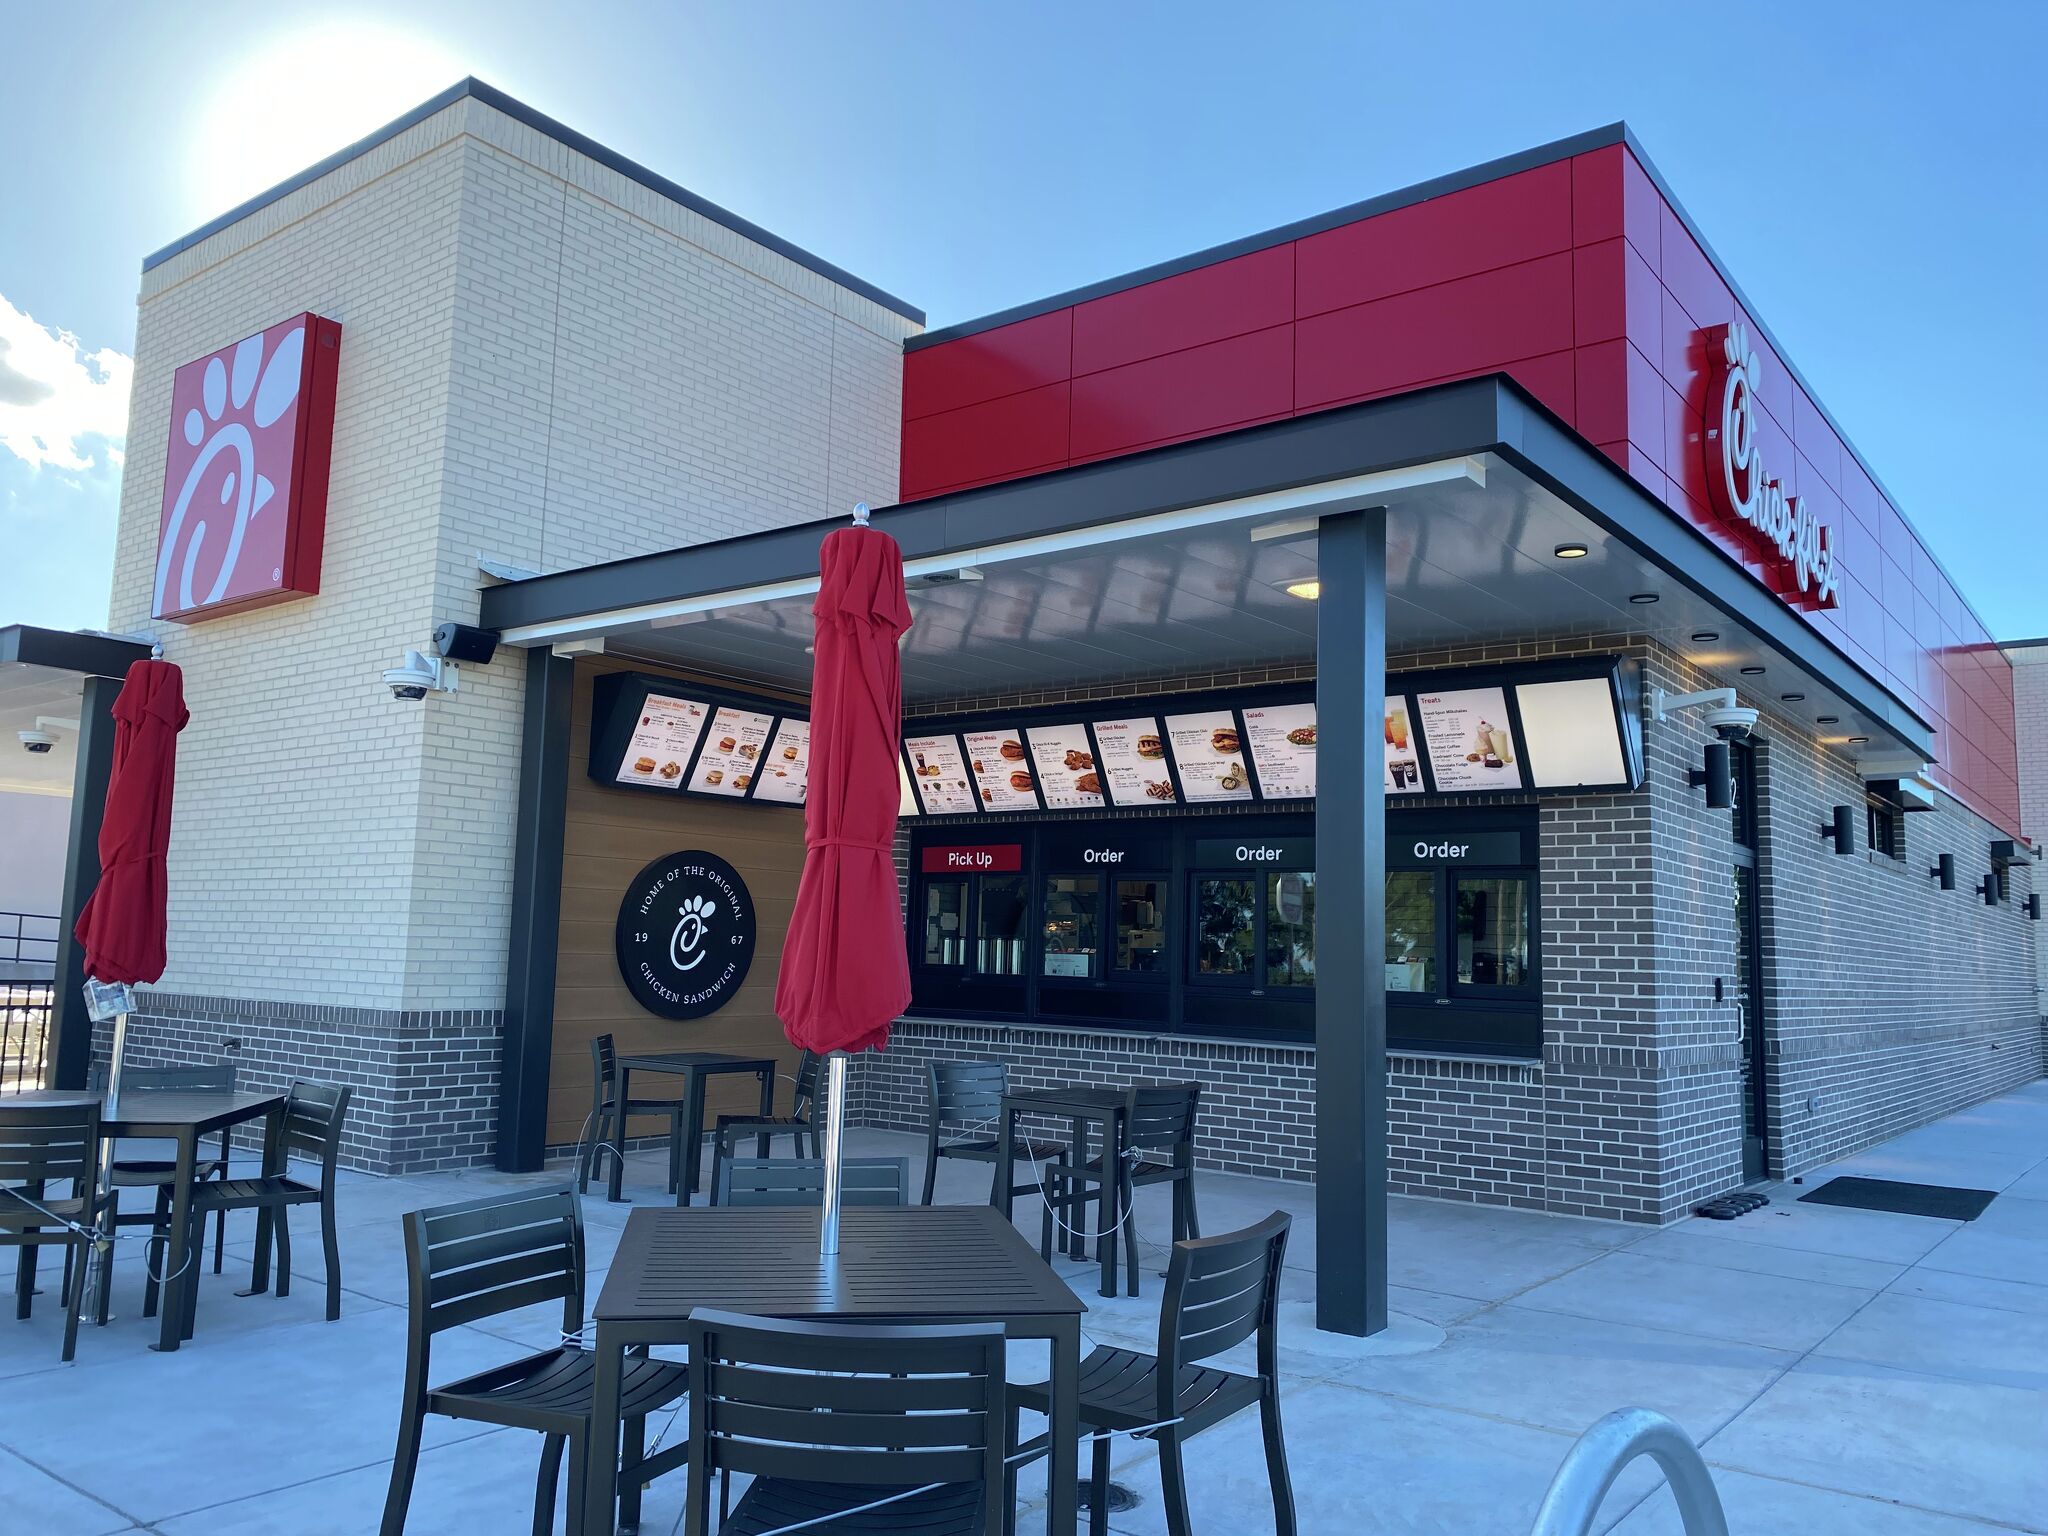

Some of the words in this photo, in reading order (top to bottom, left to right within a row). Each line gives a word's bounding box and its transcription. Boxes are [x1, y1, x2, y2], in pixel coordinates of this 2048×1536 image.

[1722, 322, 1840, 609] Chick-fil-A
[1083, 849, 1125, 863] Order
[1235, 845, 1283, 861] Order
[1413, 841, 1469, 859] Order
[948, 852, 973, 866] Pick
[976, 851, 993, 868] Up
[640, 879, 665, 915] HOME
[666, 868, 680, 882] OF
[683, 866, 705, 876] THE
[708, 871, 743, 921] ORIGINAL
[634, 932, 648, 943] 19
[730, 935, 744, 945] 67
[640, 962, 680, 1003] CHICKEN
[683, 962, 736, 1004] SANDWICH
